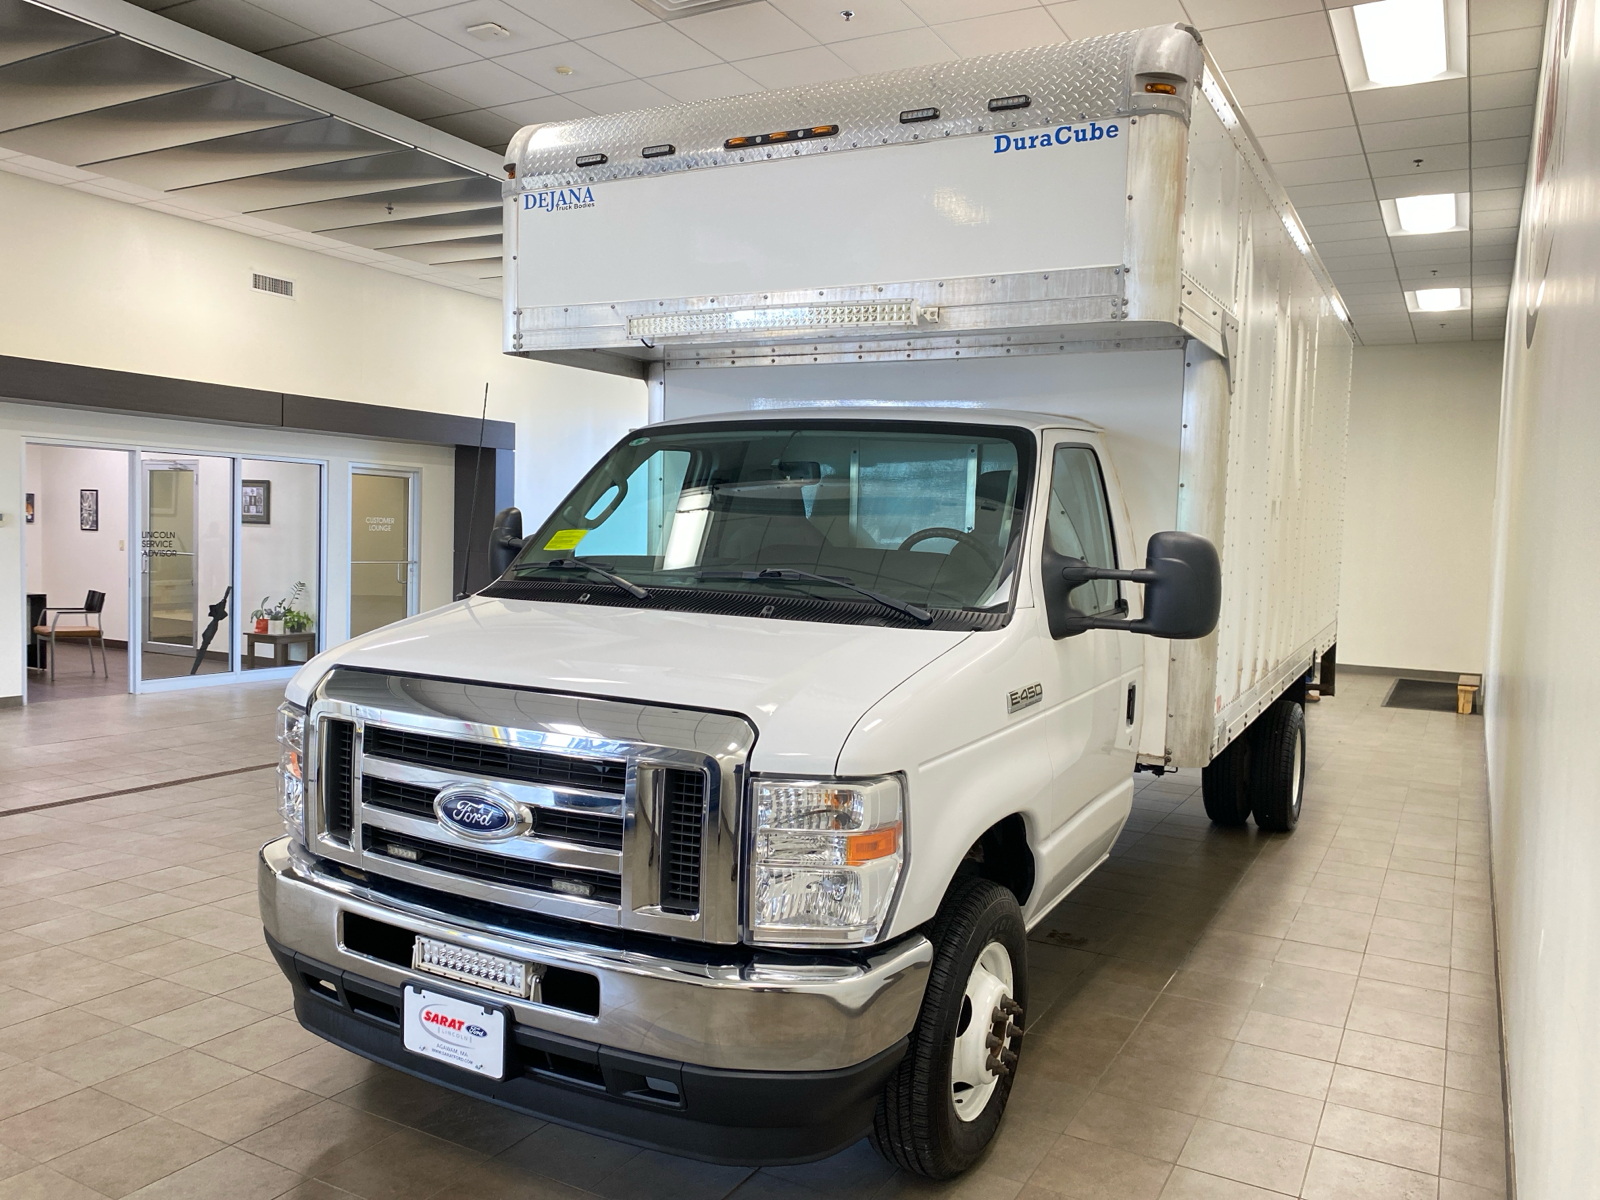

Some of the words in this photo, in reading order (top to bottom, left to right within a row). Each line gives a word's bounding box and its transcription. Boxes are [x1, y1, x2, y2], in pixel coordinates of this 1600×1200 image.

[994, 123, 1119, 153] DuraCube
[524, 187, 595, 212] DEJANA
[365, 516, 395, 524] CUSTOMER
[141, 531, 176, 539] LINCOLN
[141, 540, 173, 548] SERVICE
[141, 549, 177, 557] ADVISOR
[1009, 683, 1043, 706] E-450
[452, 800, 494, 826] Ford
[423, 1010, 465, 1031] SARAT
[467, 1025, 485, 1037] Ford
[441, 1029, 468, 1041] LINCOLN
